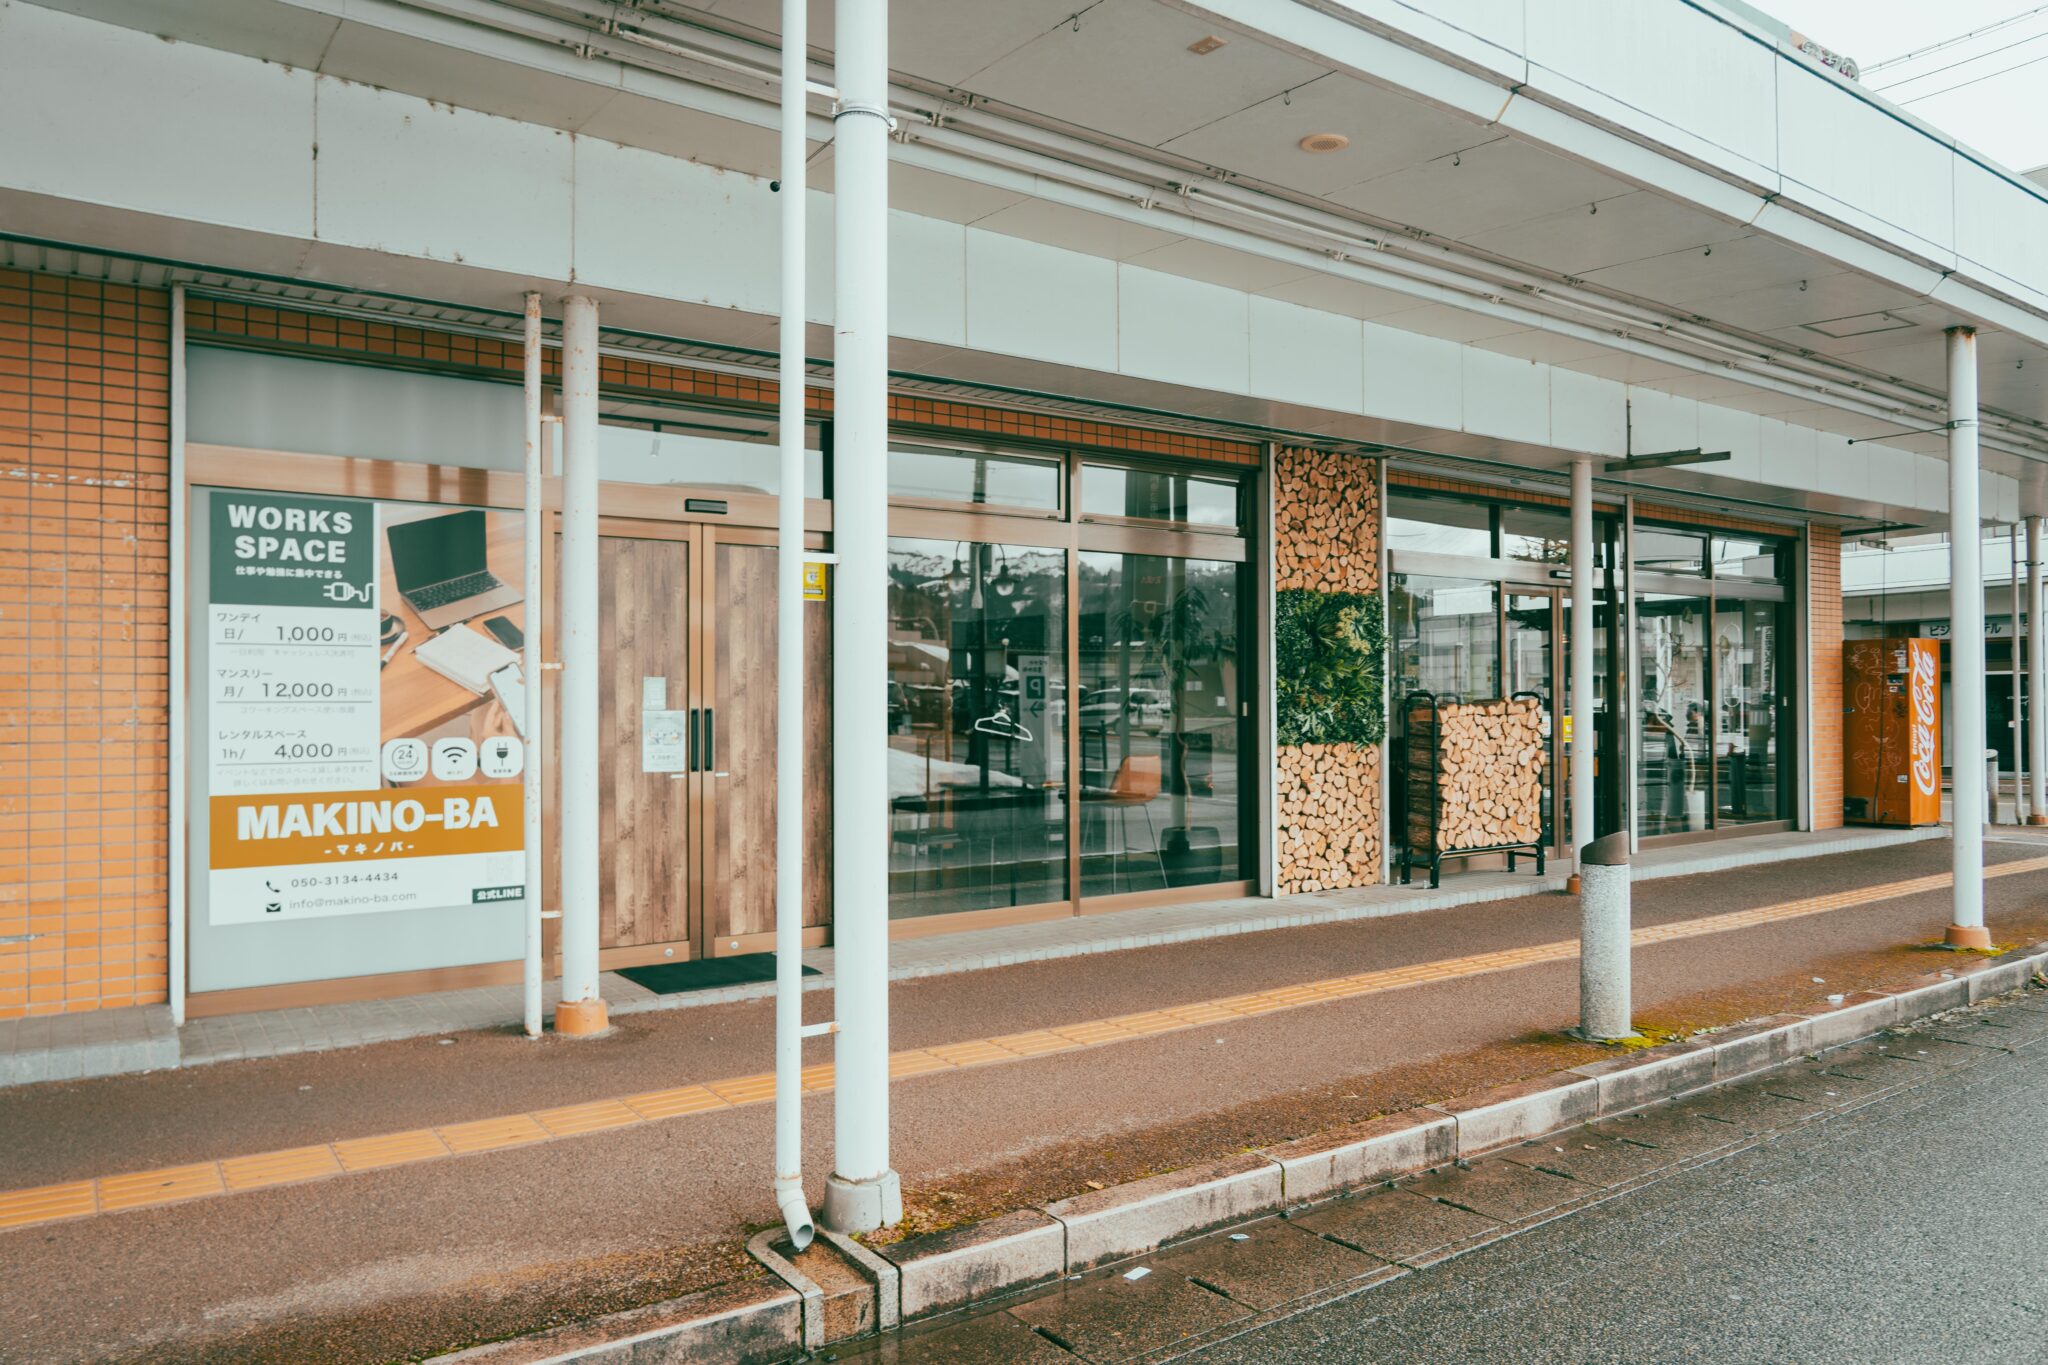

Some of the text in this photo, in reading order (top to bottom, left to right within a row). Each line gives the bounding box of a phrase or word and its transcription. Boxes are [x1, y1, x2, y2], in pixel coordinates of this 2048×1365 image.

[227, 503, 353, 535] WORKS
[234, 537, 347, 564] SPACE
[235, 565, 343, 580] 仕事や勉強に集中できる
[216, 612, 261, 624] ワンデイ
[216, 669, 273, 680] マンスリー
[1911, 642, 1936, 797] Coca-Cola
[218, 729, 307, 741] レンタルスペース
[397, 749, 413, 760] 24
[237, 796, 499, 841] MAKINO-BA
[291, 872, 399, 889] 050-3134-4434
[289, 891, 417, 910] info@makino-ba.com
